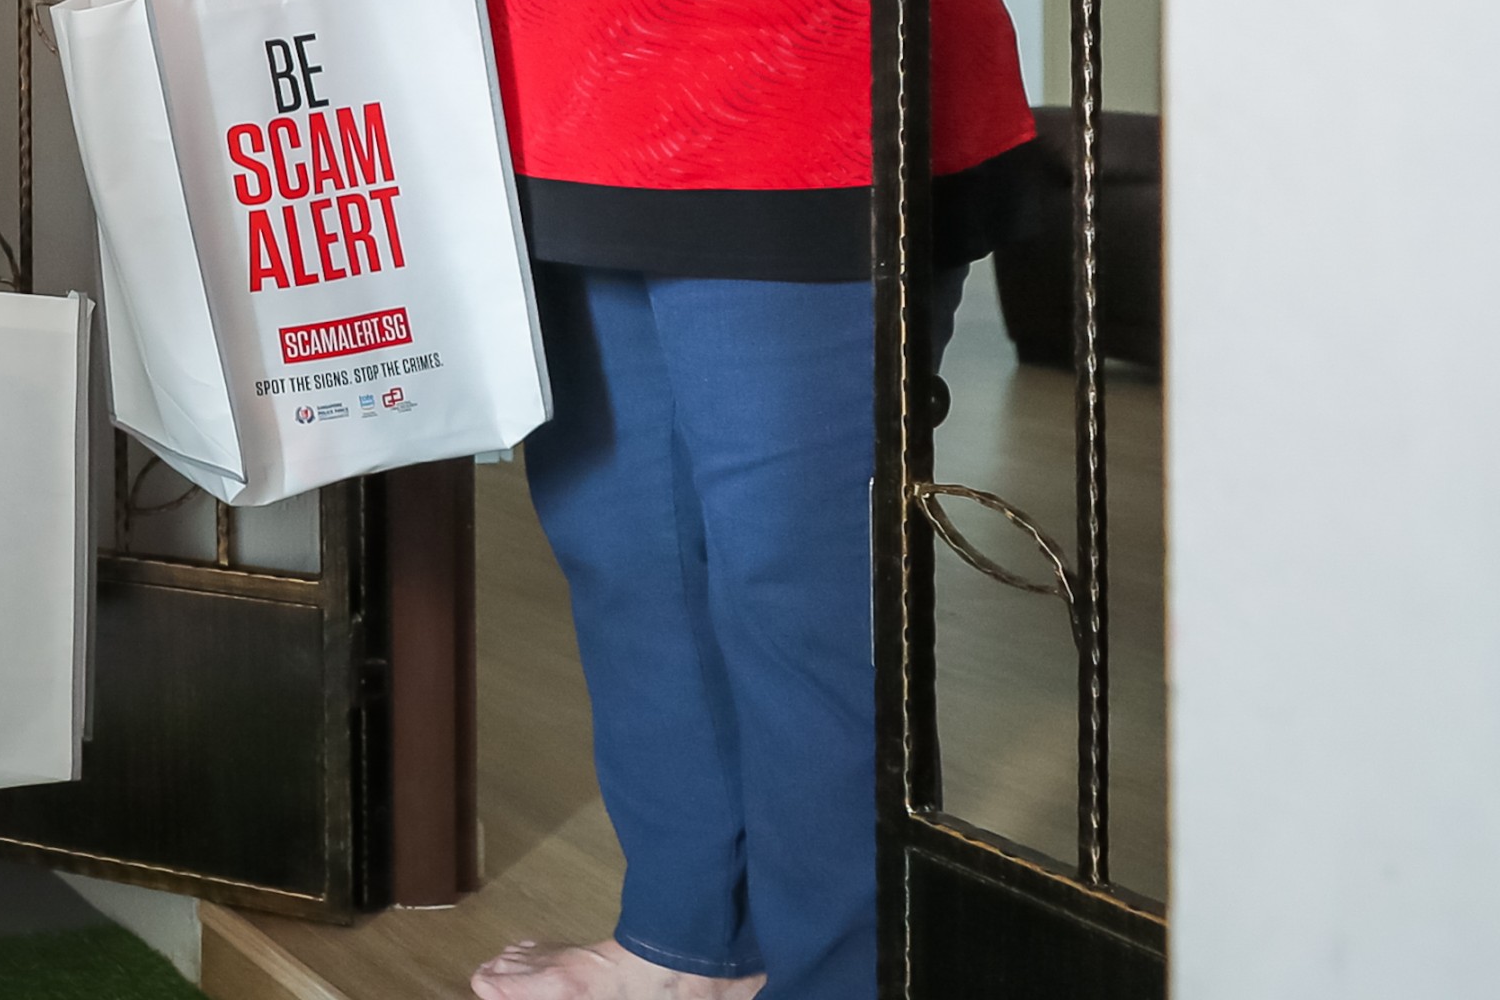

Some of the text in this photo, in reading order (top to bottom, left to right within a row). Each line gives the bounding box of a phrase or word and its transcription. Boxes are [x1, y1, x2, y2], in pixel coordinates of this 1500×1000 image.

[265, 33, 329, 114] BE
[227, 102, 395, 205] SCAM
[249, 186, 405, 292] ALERT
[255, 352, 444, 396] SPOT THE SIGNS. STOP THE CRIMES.
[284, 313, 408, 358] SCAMALERT.SG
